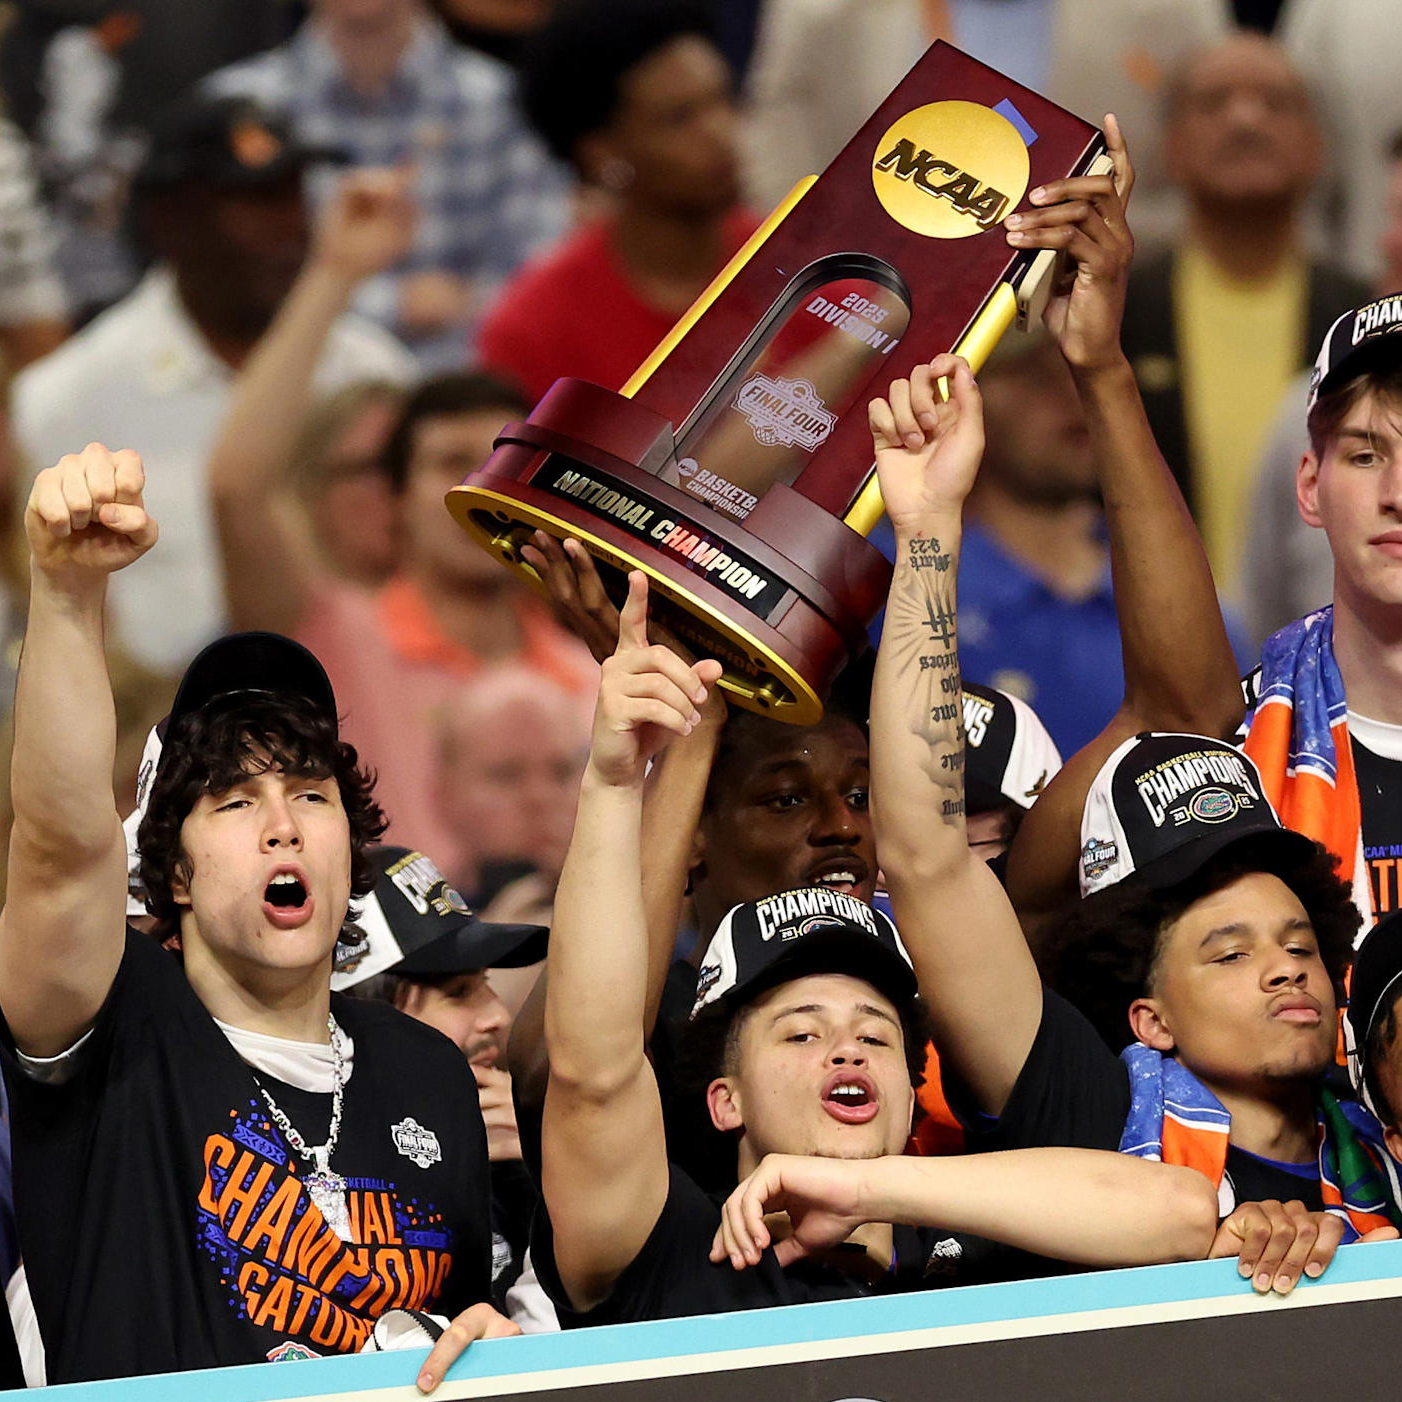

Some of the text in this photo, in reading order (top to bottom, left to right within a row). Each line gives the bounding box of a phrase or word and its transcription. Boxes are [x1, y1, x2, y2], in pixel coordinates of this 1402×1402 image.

[875, 138, 1009, 231] NCAA
[806, 296, 890, 350] DIVISION
[840, 292, 890, 324] 2025
[745, 385, 828, 437] FINAL FOUR
[686, 480, 749, 519] CHAMPIONSHI
[694, 469, 758, 511] BASKETB
[552, 470, 654, 531] NATIONAL
[650, 519, 768, 600] CHAMPION
[909, 537, 940, 553] 9:23
[909, 554, 950, 572] Mark
[1156, 751, 1204, 772] BASKETBALL
[1138, 756, 1259, 828] CHAMPIONS
[1173, 812, 1185, 821] 20
[780, 888, 830, 899] BASKETBALL
[756, 892, 878, 941] CHAMPIONS
